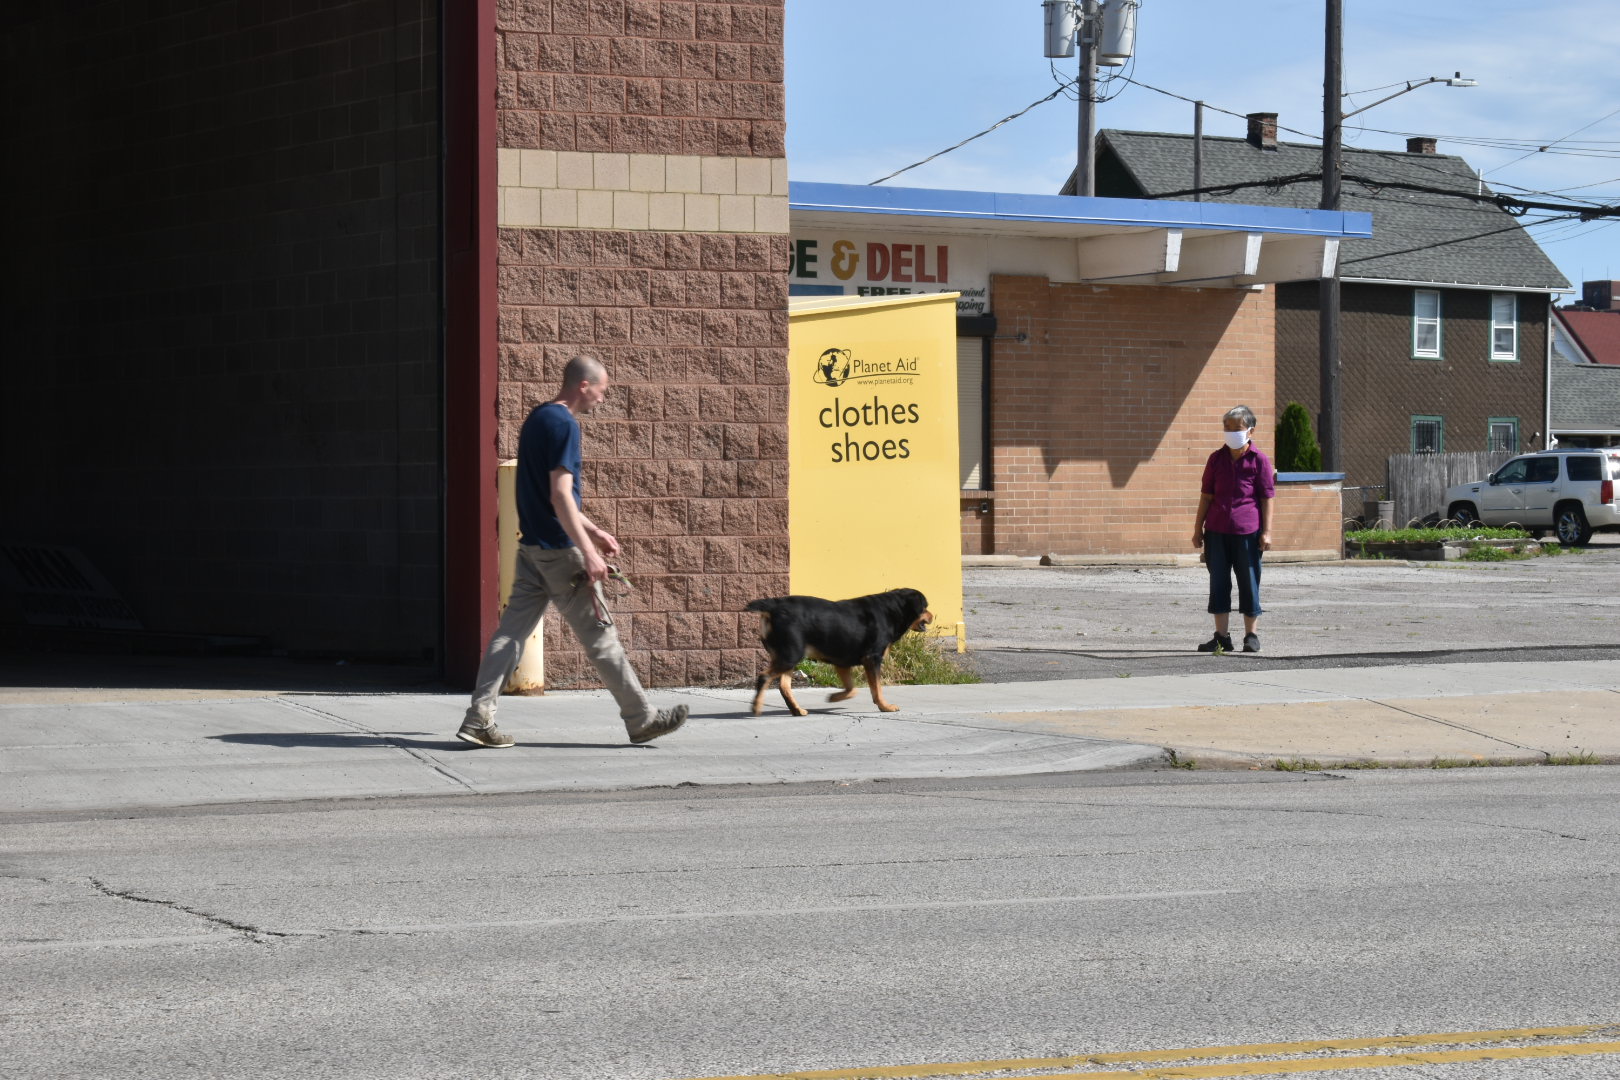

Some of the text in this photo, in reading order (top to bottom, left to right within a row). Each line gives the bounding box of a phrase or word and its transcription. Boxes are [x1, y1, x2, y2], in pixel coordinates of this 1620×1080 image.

[831, 239, 860, 281] &
[866, 242, 949, 284] DELI
[853, 356, 917, 373] Planet Aid
[857, 376, 914, 387] www.planetaid.org
[819, 395, 920, 428] clothes
[831, 431, 910, 463] shoes
